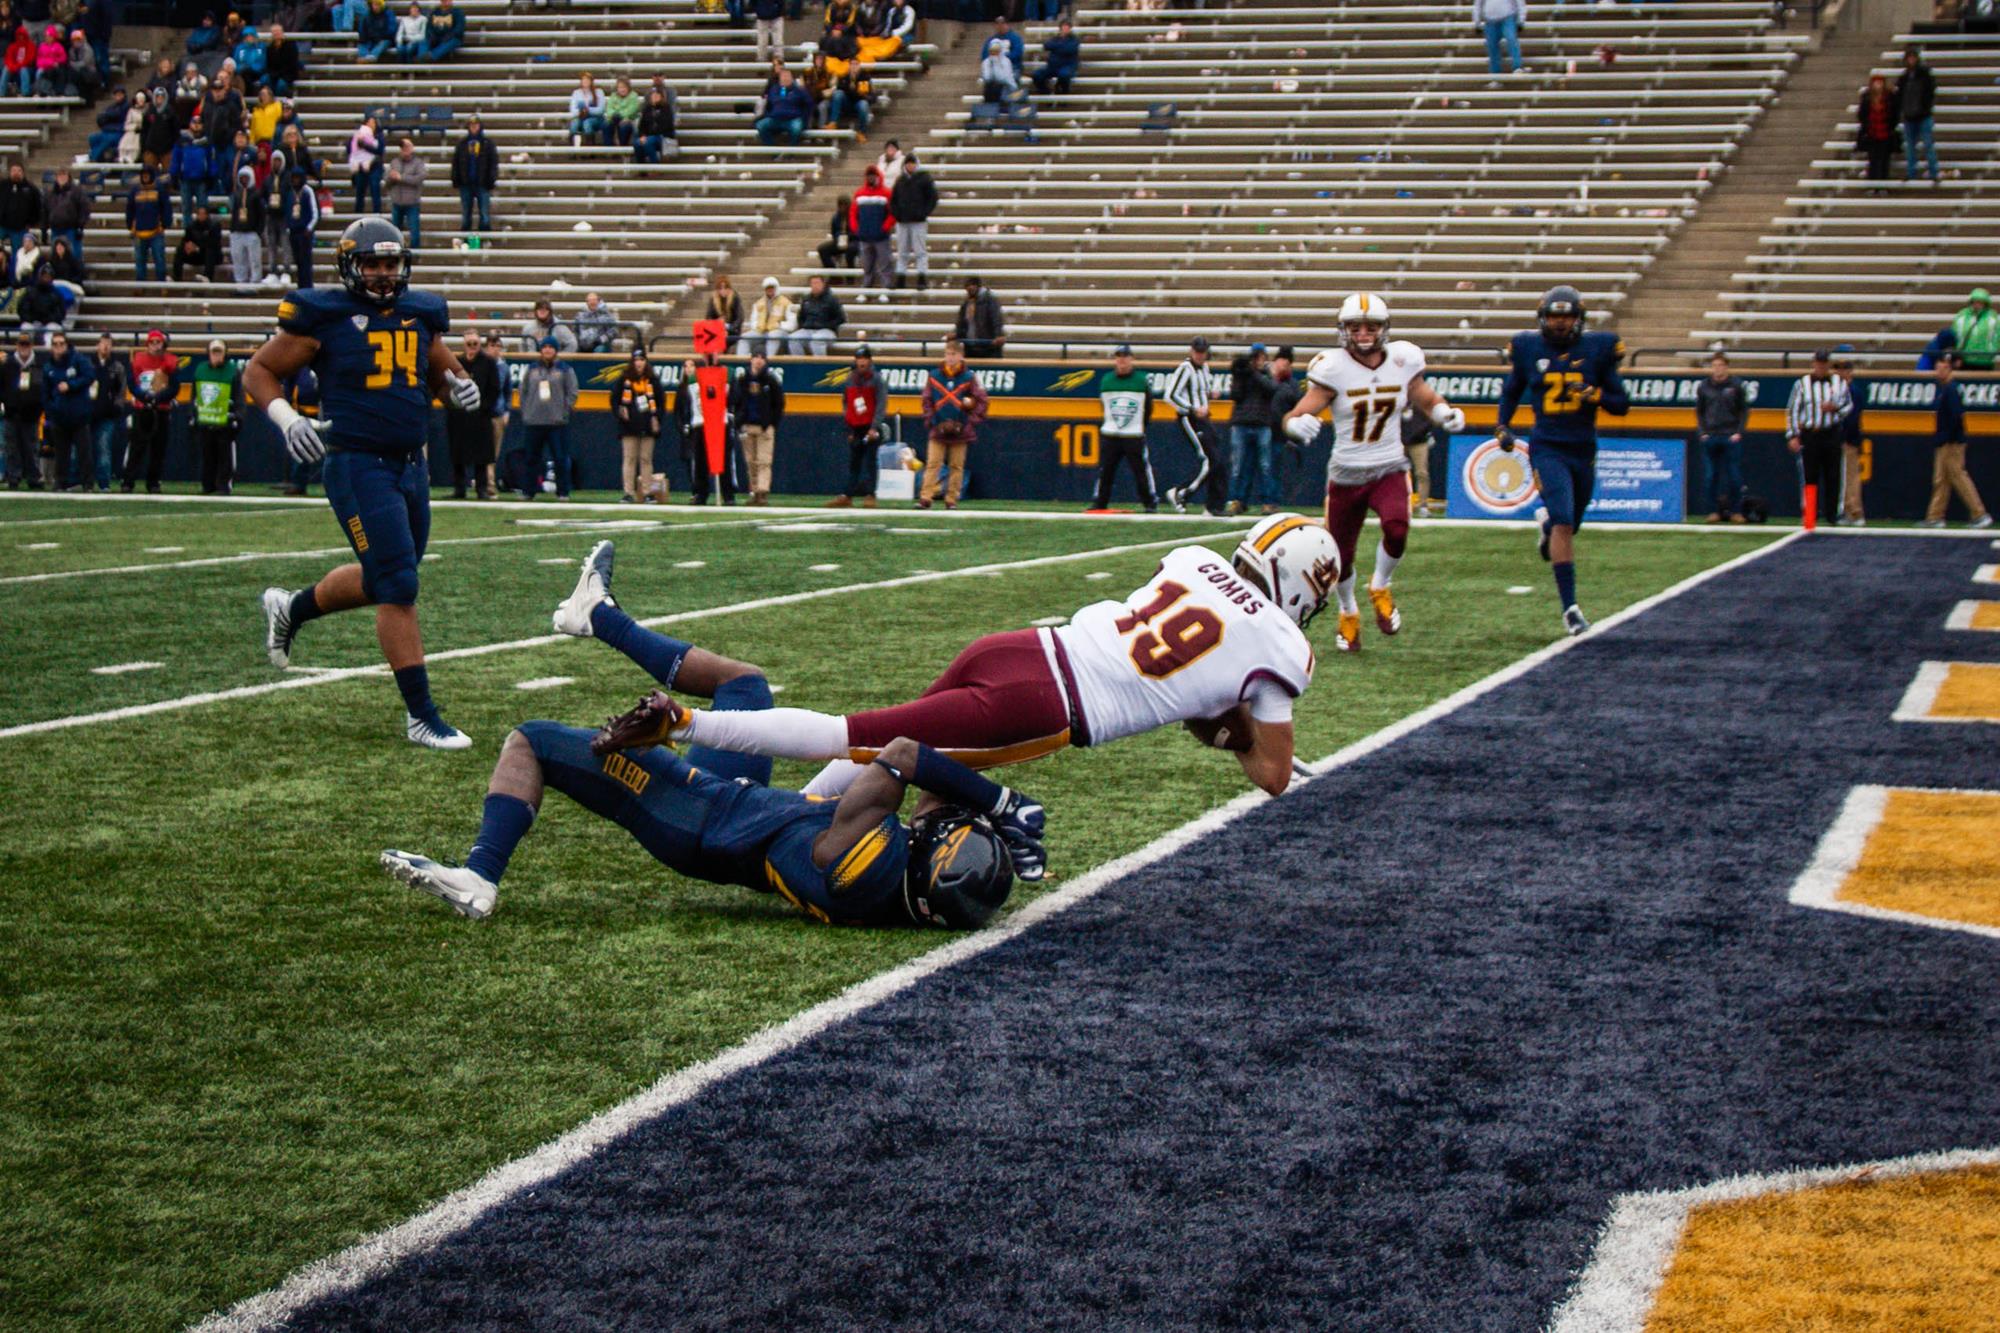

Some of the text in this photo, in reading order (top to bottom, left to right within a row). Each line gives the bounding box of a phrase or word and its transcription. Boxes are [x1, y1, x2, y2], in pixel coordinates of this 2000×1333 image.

[366, 330, 418, 388] 34
[880, 369, 928, 388] TOLED
[1868, 382, 1937, 406] TOLEDO
[1352, 397, 1397, 443] 17
[1054, 424, 1100, 467] 10
[1197, 562, 1265, 616] COMBS
[1114, 579, 1226, 682] 19
[602, 752, 651, 796] TOLEDO
